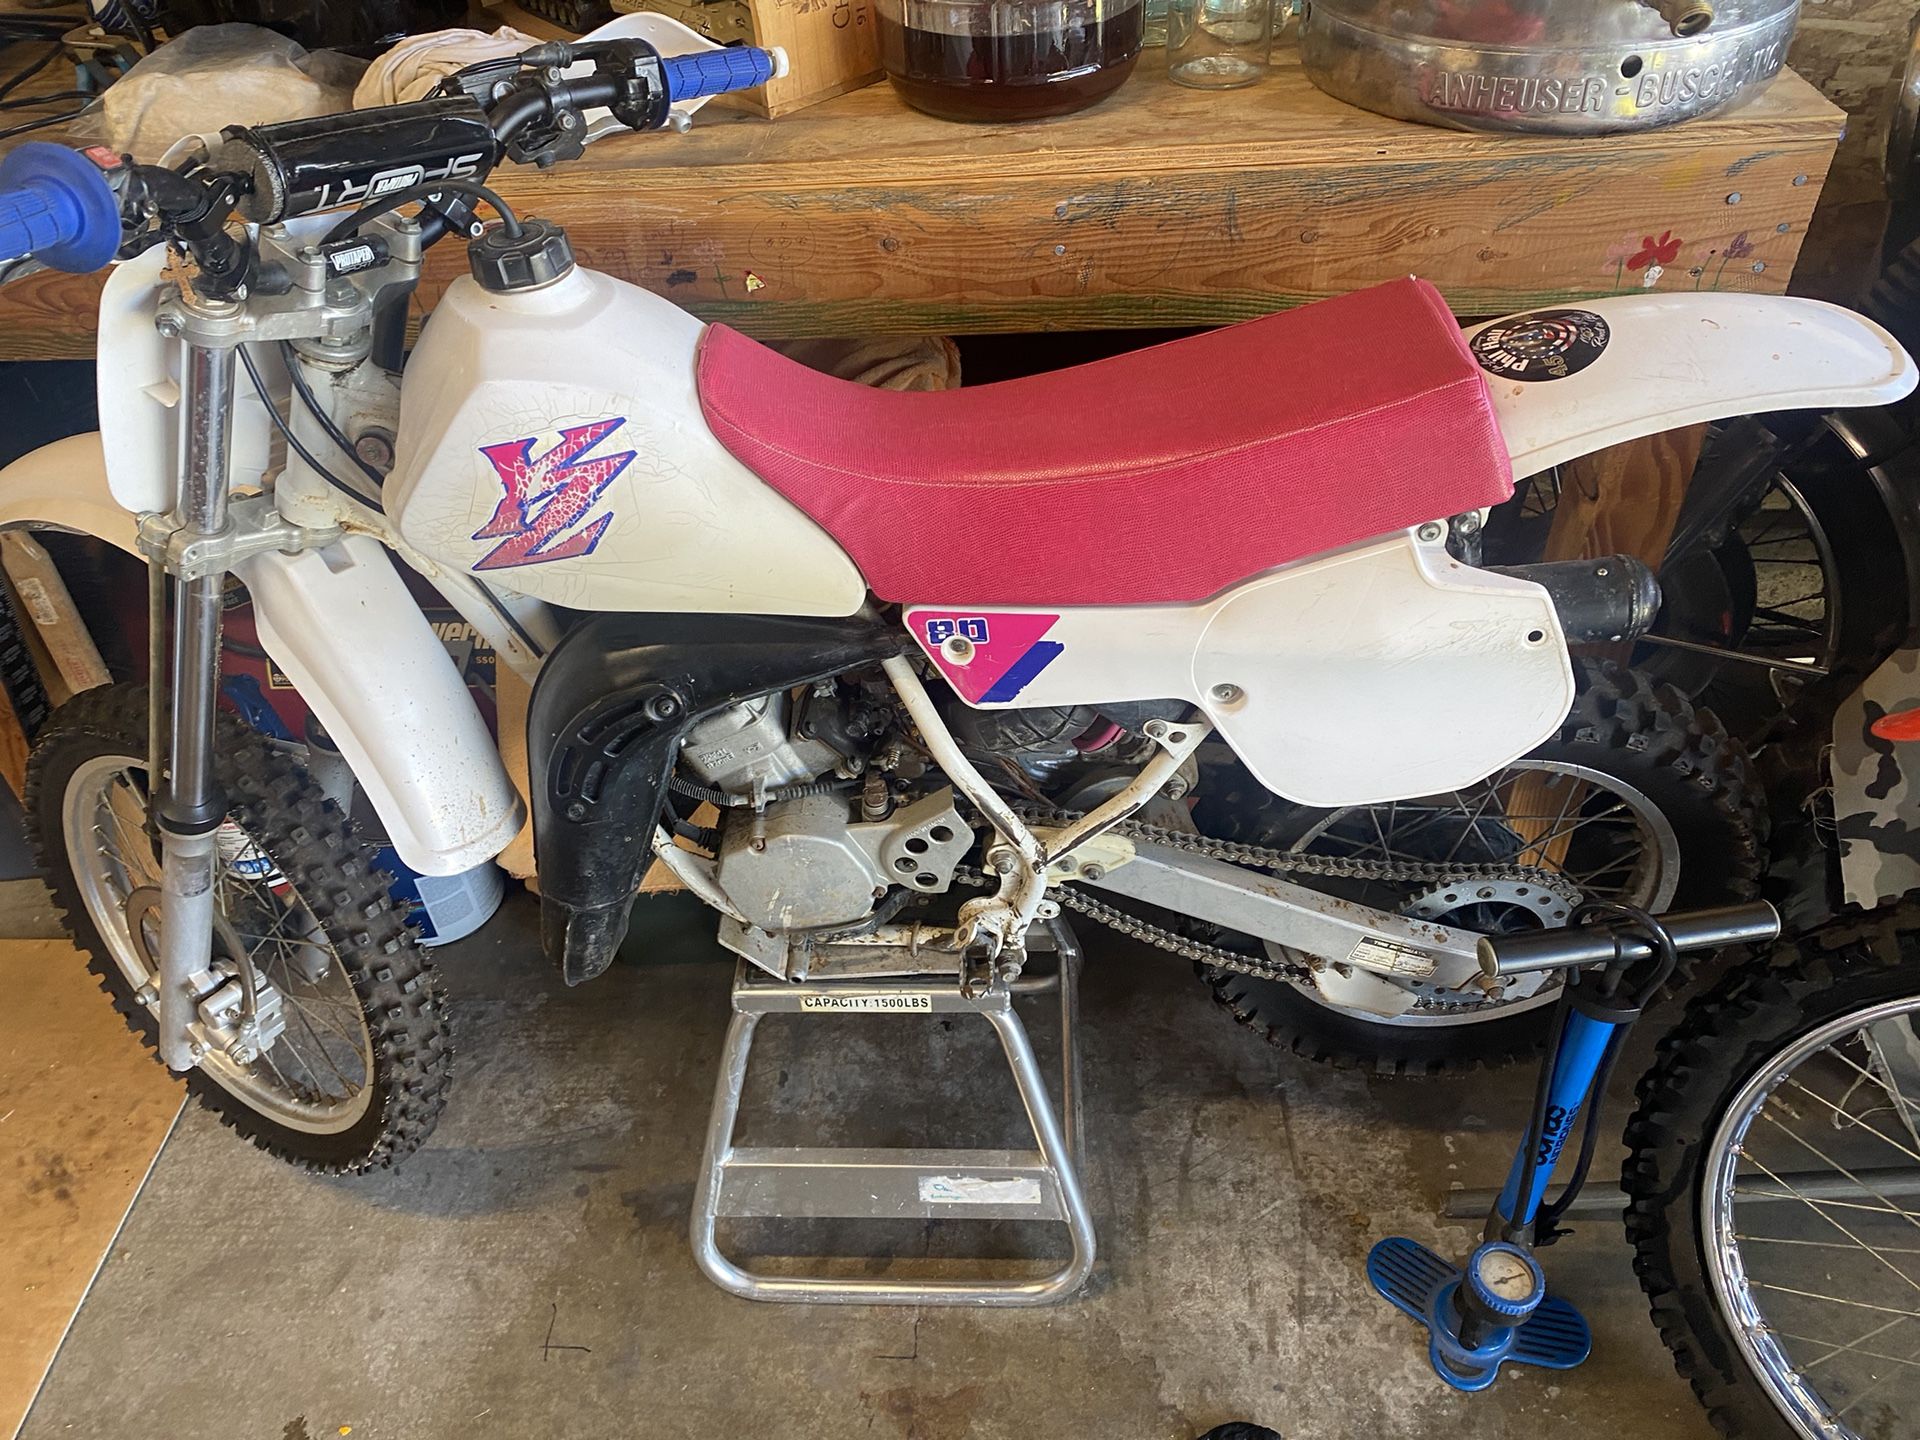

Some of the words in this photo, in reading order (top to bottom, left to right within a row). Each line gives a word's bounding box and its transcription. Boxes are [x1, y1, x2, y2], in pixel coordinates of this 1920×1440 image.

[1430, 70, 1609, 114] ANHEUSER
[1482, 329, 1507, 351] Hall
[1488, 348, 1530, 373] Phil
[1543, 355, 1569, 377] 45
[926, 616, 990, 646] 80
